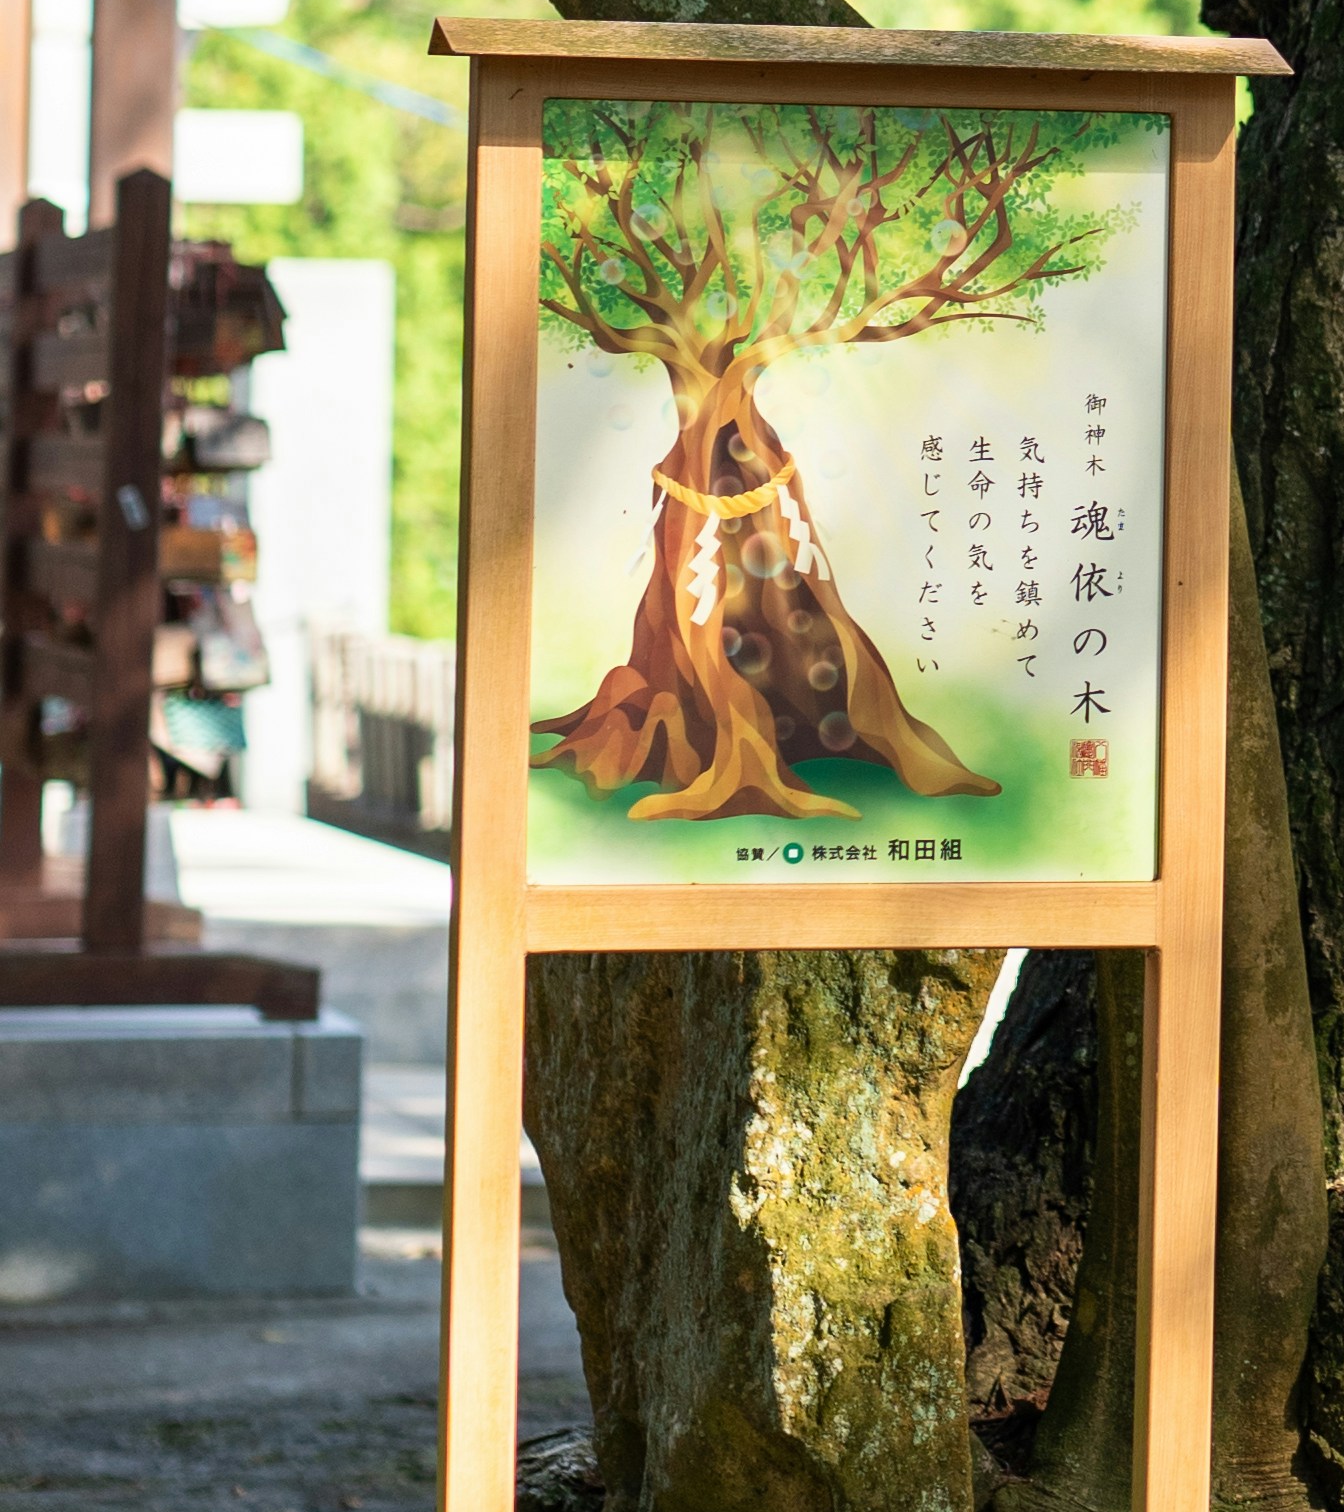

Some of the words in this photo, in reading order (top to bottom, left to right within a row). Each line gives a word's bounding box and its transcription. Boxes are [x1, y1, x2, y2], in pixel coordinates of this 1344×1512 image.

[967, 435, 996, 606] 生命の気を
[1084, 393, 1107, 477] 御神木
[916, 434, 944, 673] 感じてください
[1014, 436, 1045, 678] 気持ちを鎮めて
[1069, 500, 1115, 724] 魂依の木
[812, 844, 878, 861] 株式会社
[887, 838, 963, 862] 和田組
